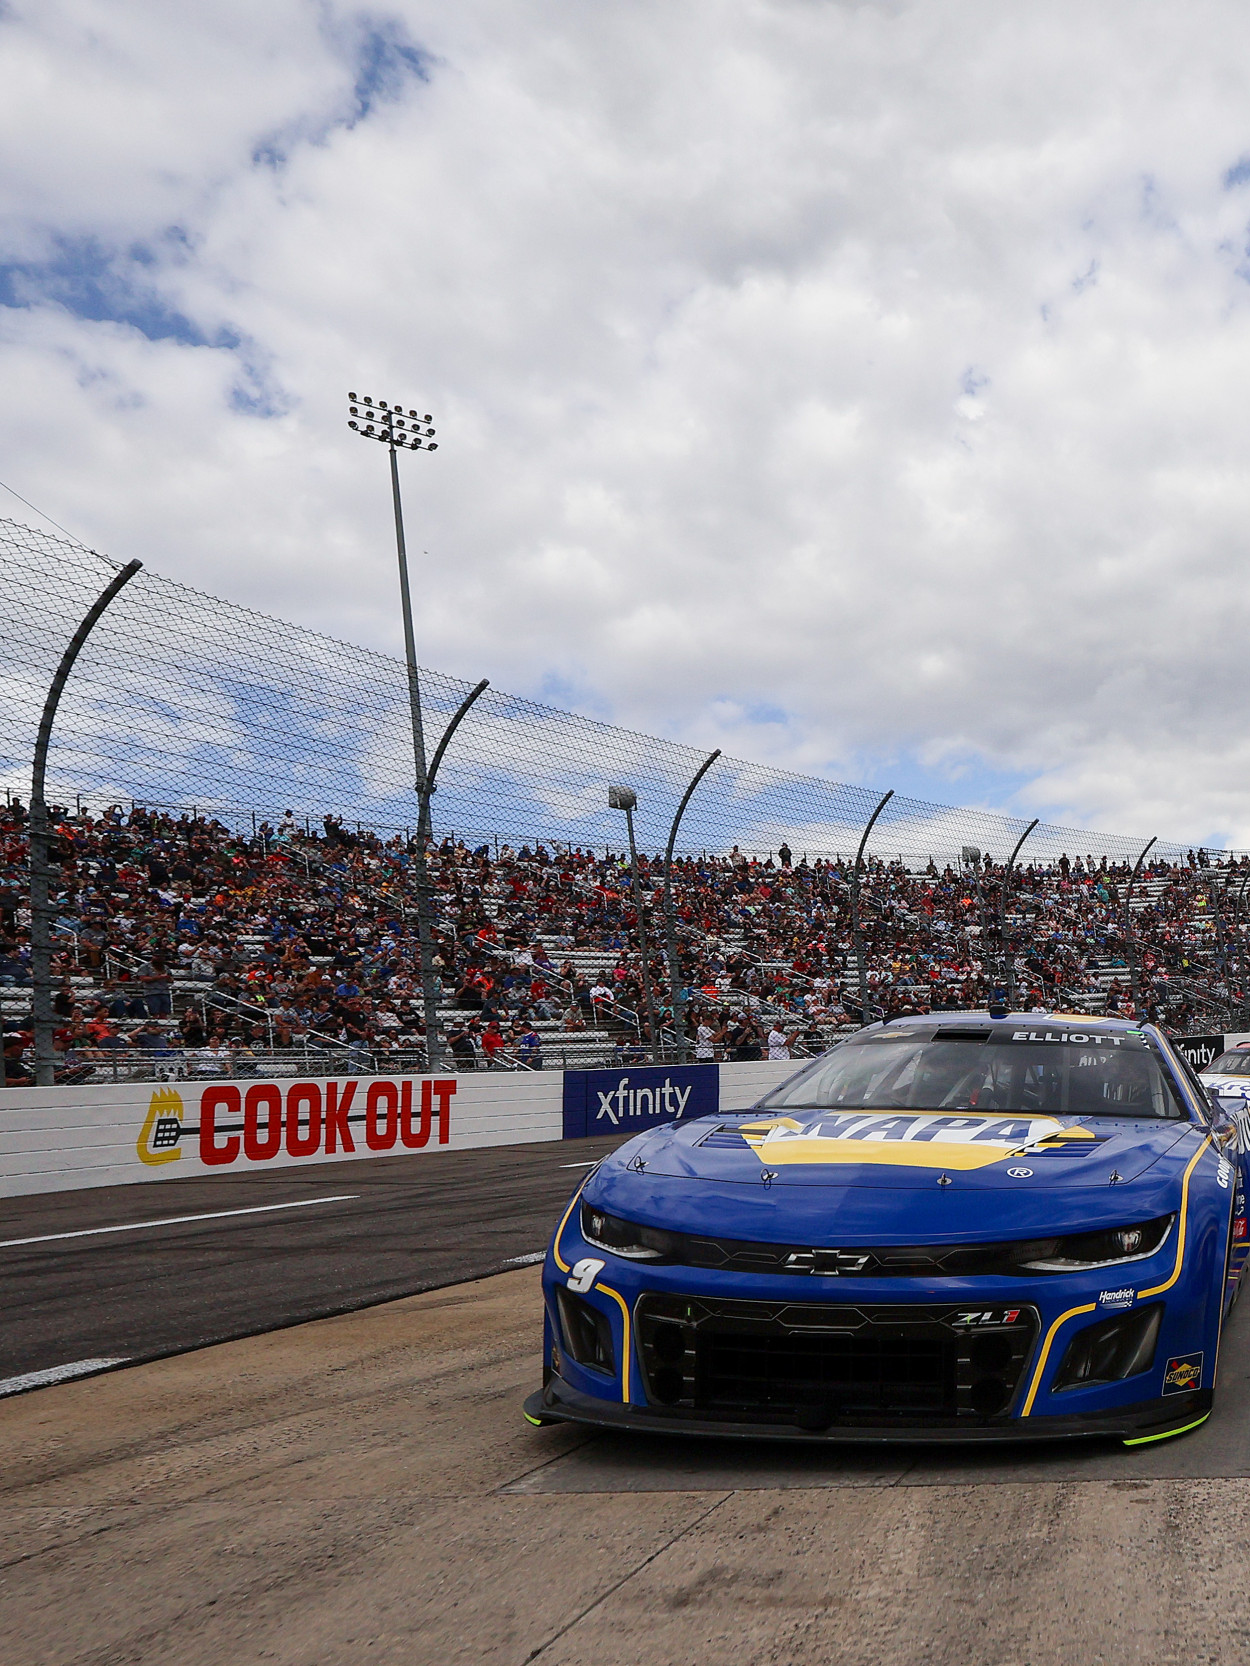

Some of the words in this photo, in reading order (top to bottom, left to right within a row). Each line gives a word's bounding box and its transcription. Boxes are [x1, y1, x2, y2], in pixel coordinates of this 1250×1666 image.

[1012, 1031, 1126, 1046] ELLIOTT
[596, 1077, 692, 1125] xfinity
[200, 1081, 359, 1166] COOK
[366, 1079, 457, 1151] OUT
[783, 1113, 1033, 1144] NAPA
[566, 1257, 606, 1294] 9
[1099, 1288, 1135, 1304] Hendrick
[951, 1310, 1021, 1327] ZL1
[1166, 1367, 1201, 1384] SUNOCO
